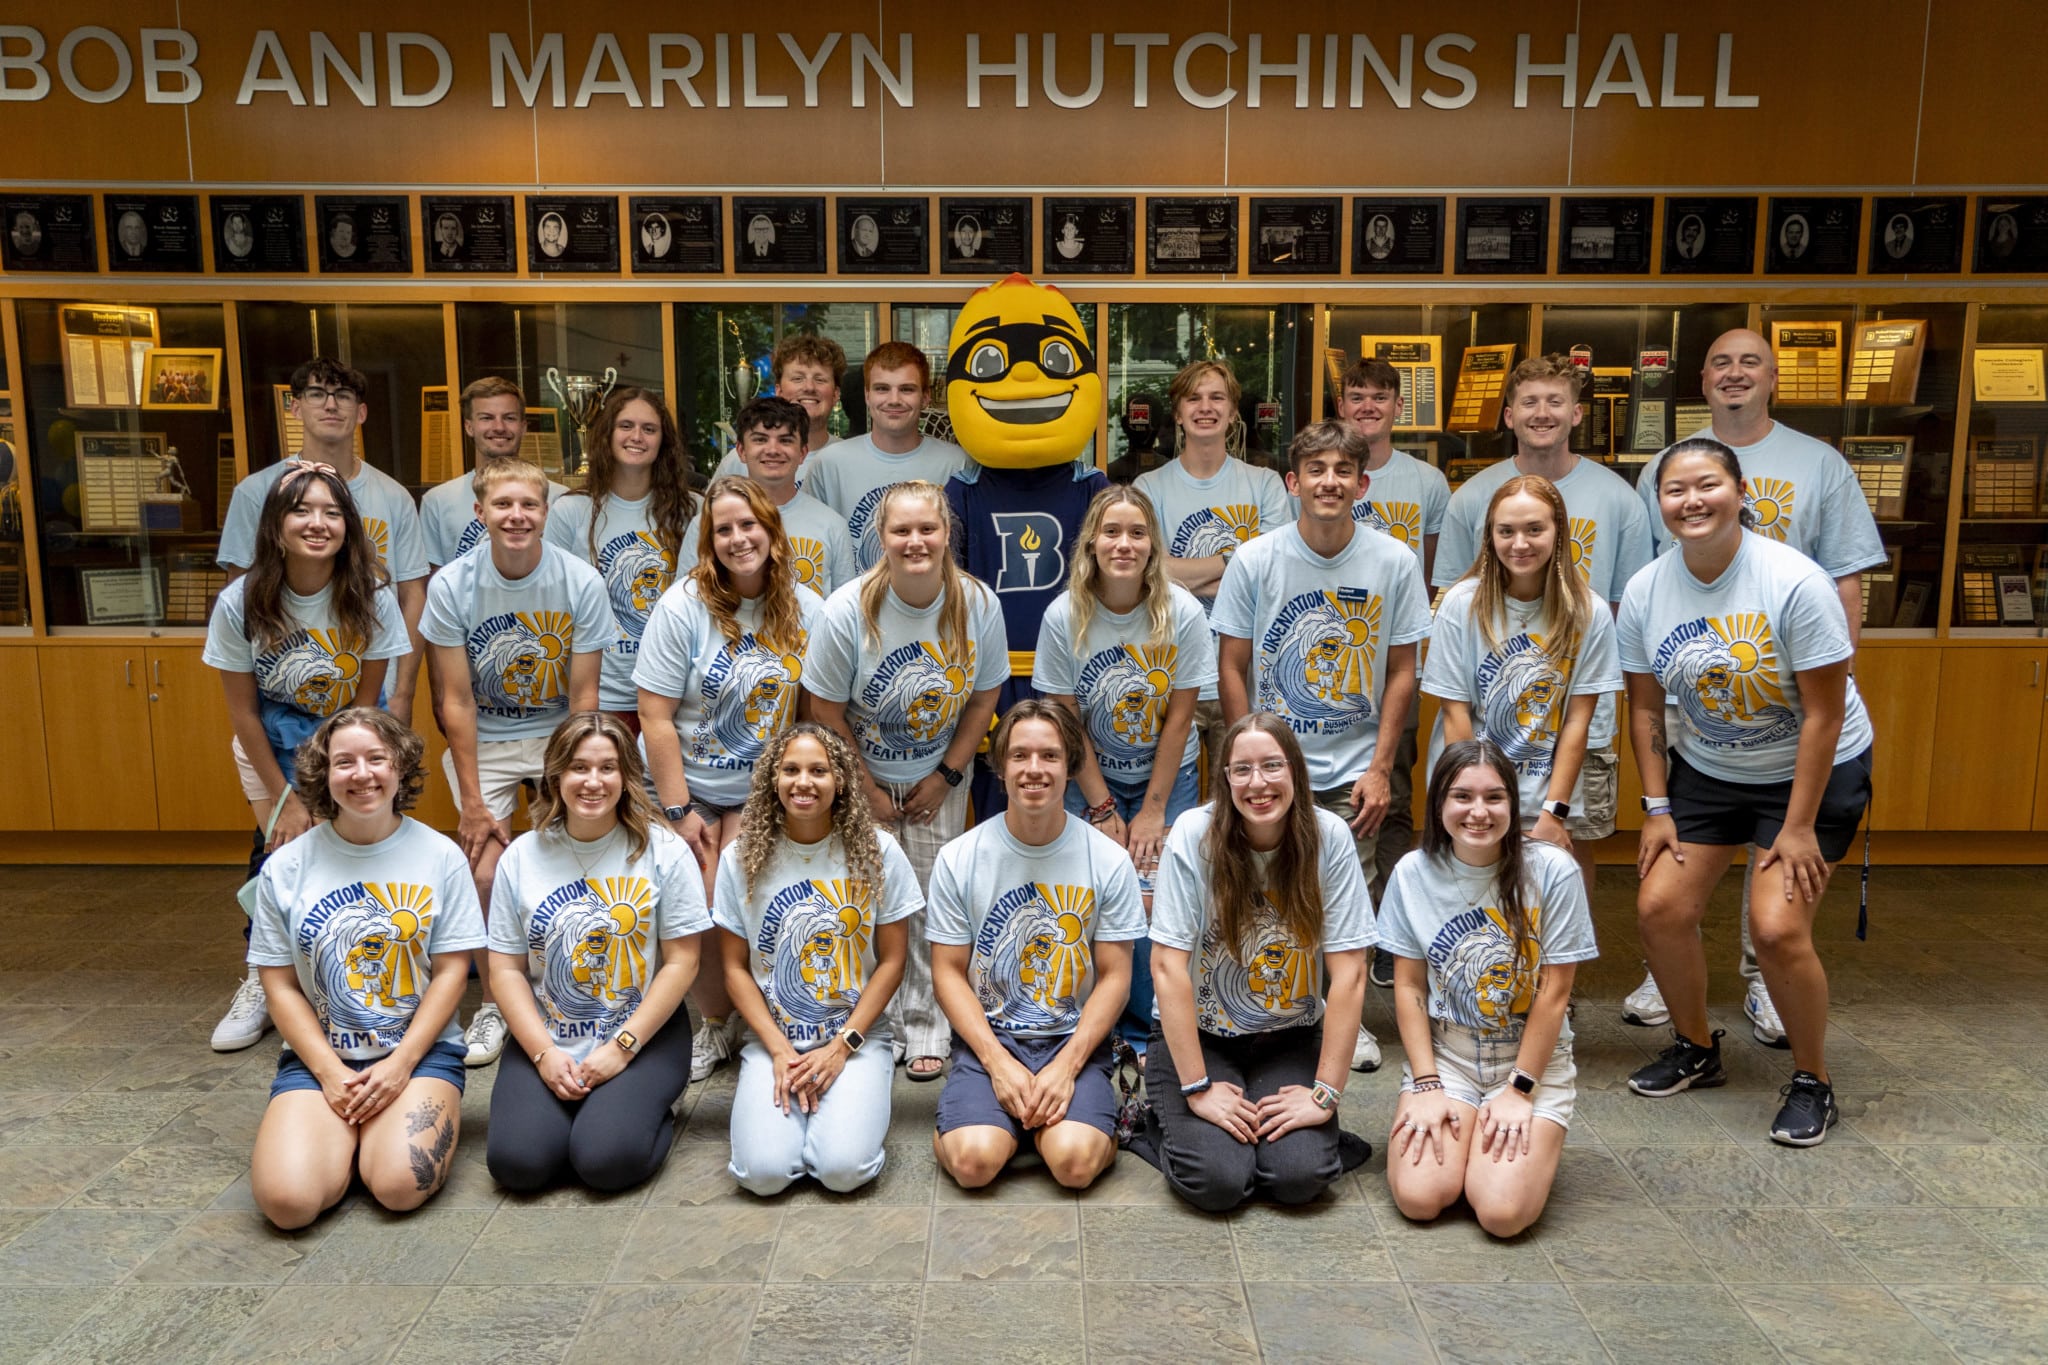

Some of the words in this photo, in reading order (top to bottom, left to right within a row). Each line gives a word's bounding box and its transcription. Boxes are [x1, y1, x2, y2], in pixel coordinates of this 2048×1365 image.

[0, 25, 202, 104] BOB
[236, 30, 453, 107] AND
[489, 32, 914, 108] MARILYN
[966, 31, 1478, 109] HUTCHINS
[1513, 33, 1760, 108] HALL
[1263, 589, 1325, 654] ORIENTATION
[862, 640, 924, 708] ORIENTATION
[708, 755, 753, 772] TEAM
[865, 739, 908, 760] TEAM
[528, 878, 589, 951] ORIENTATION
[758, 879, 814, 954] ORIENTATION
[976, 881, 1038, 957] ORIENTATION
[331, 1032, 372, 1049] EAM
[553, 1021, 596, 1039] TEAM
[782, 1024, 821, 1041] TEAM
